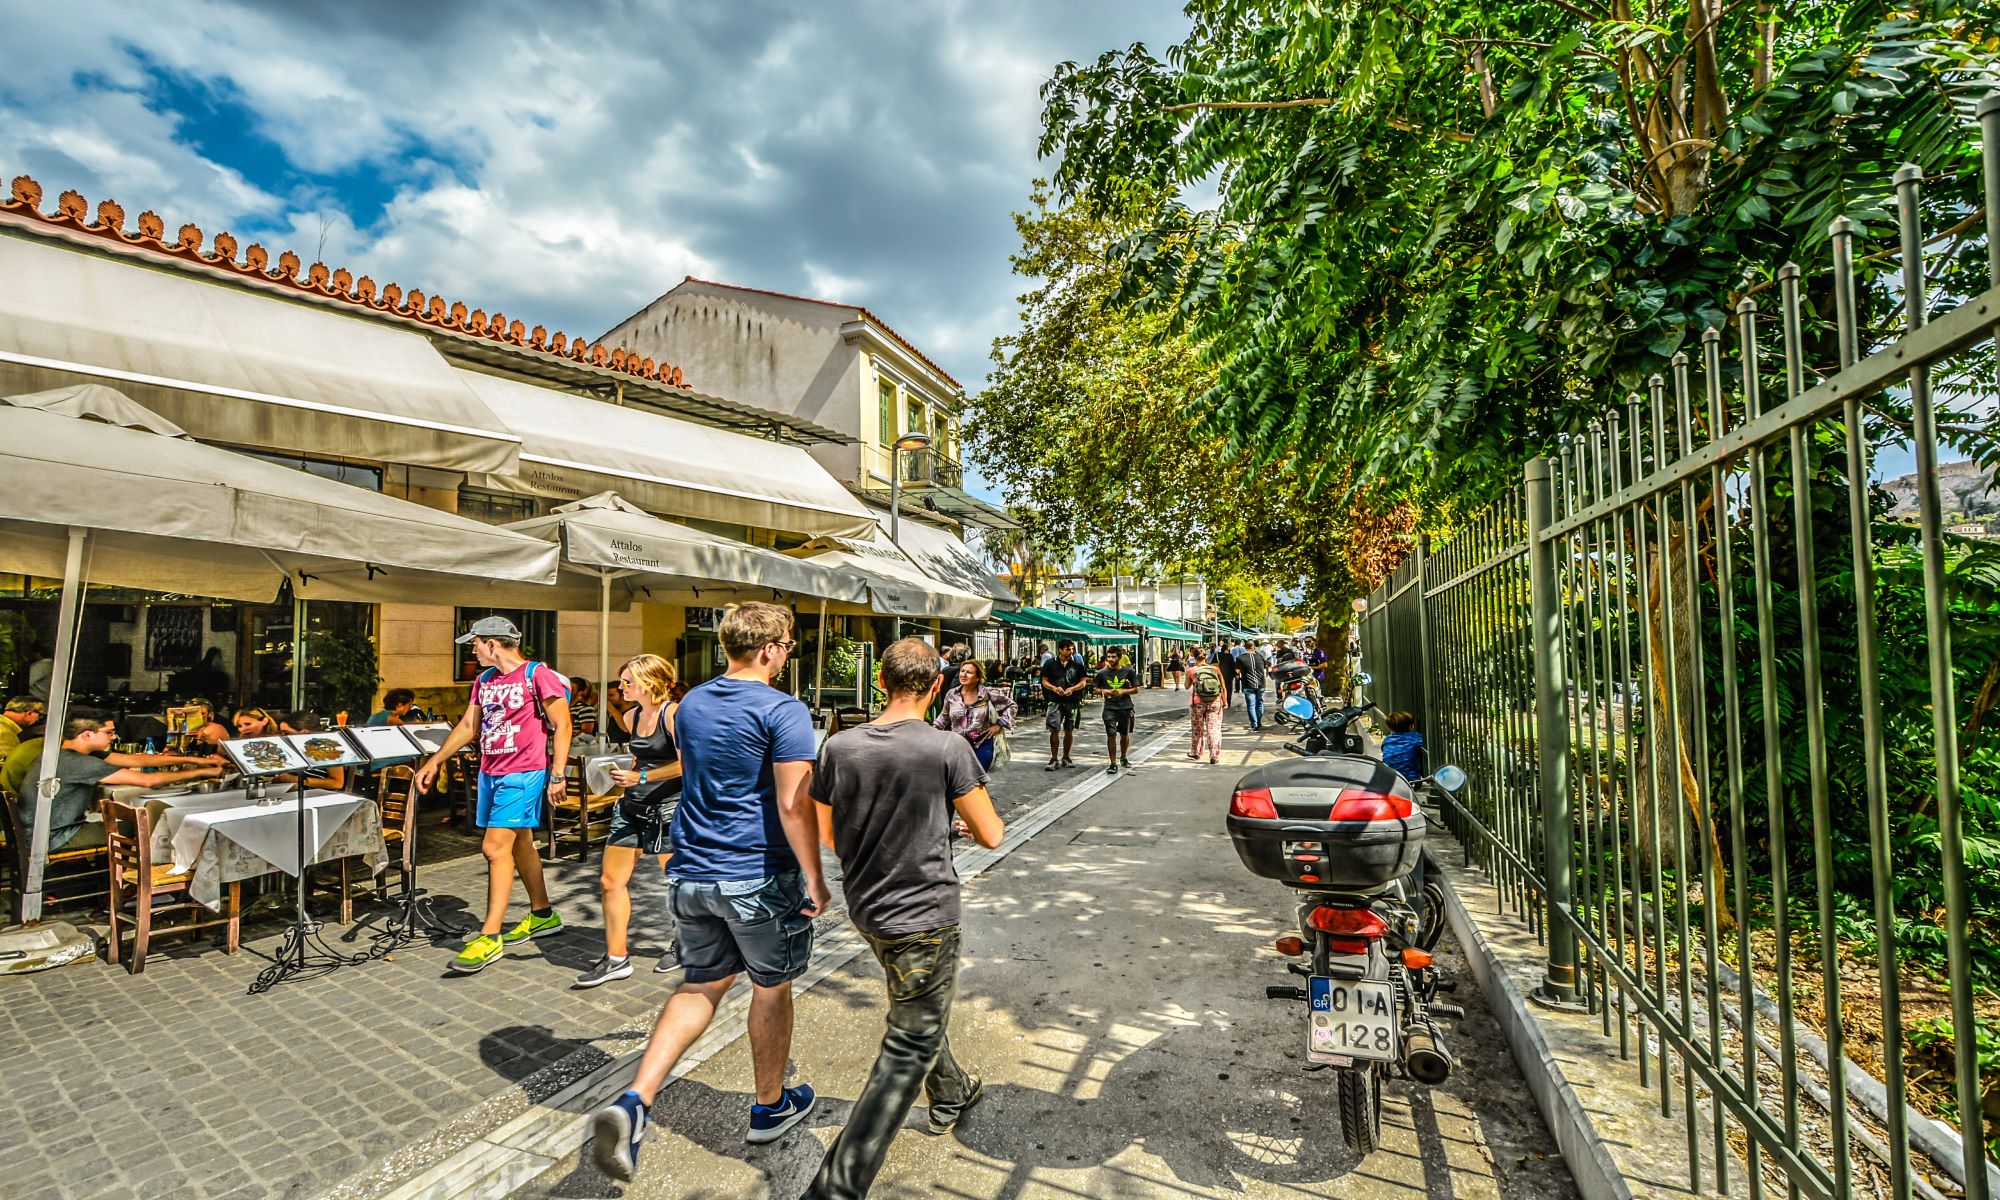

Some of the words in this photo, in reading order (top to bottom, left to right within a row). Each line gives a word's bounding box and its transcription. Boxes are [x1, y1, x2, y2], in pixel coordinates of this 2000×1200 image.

[531, 470, 564, 482] Attalos
[530, 481, 580, 495] Restaurant
[610, 539, 643, 552] Attalos
[613, 553, 660, 568] Restaurant
[1313, 999, 1328, 1009] GR
[1335, 1022, 1391, 1051] 128
